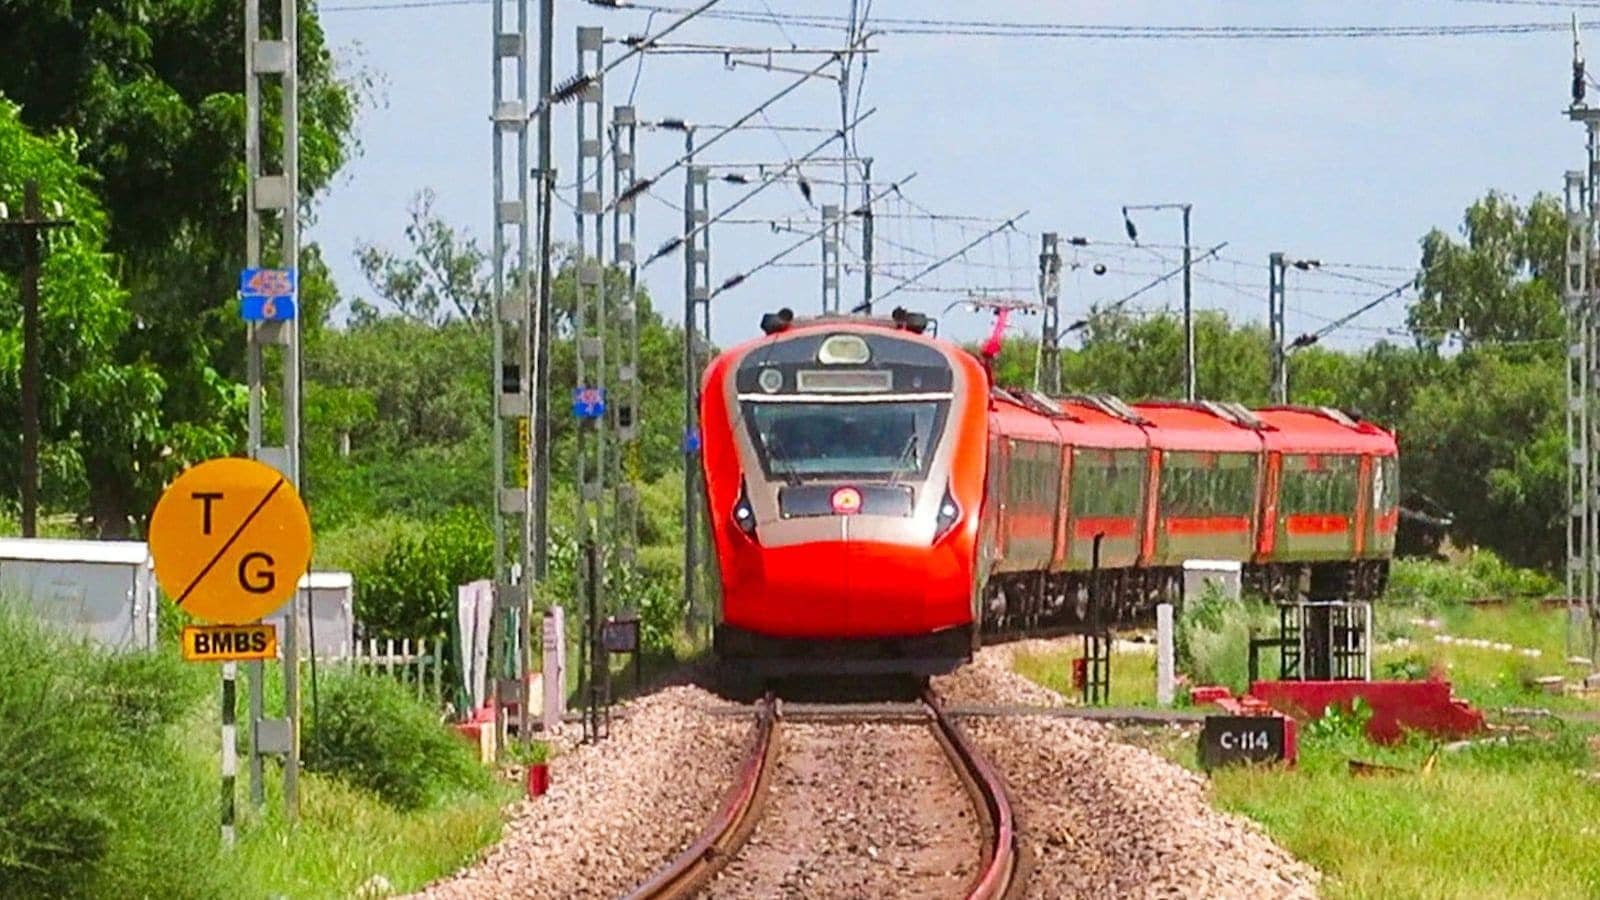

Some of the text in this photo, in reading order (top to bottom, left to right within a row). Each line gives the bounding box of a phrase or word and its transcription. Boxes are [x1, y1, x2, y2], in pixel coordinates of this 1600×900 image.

[191, 492, 224, 535] T
[238, 552, 275, 594] G
[194, 631, 267, 654] BMBS
[1220, 731, 1269, 750] C-114
